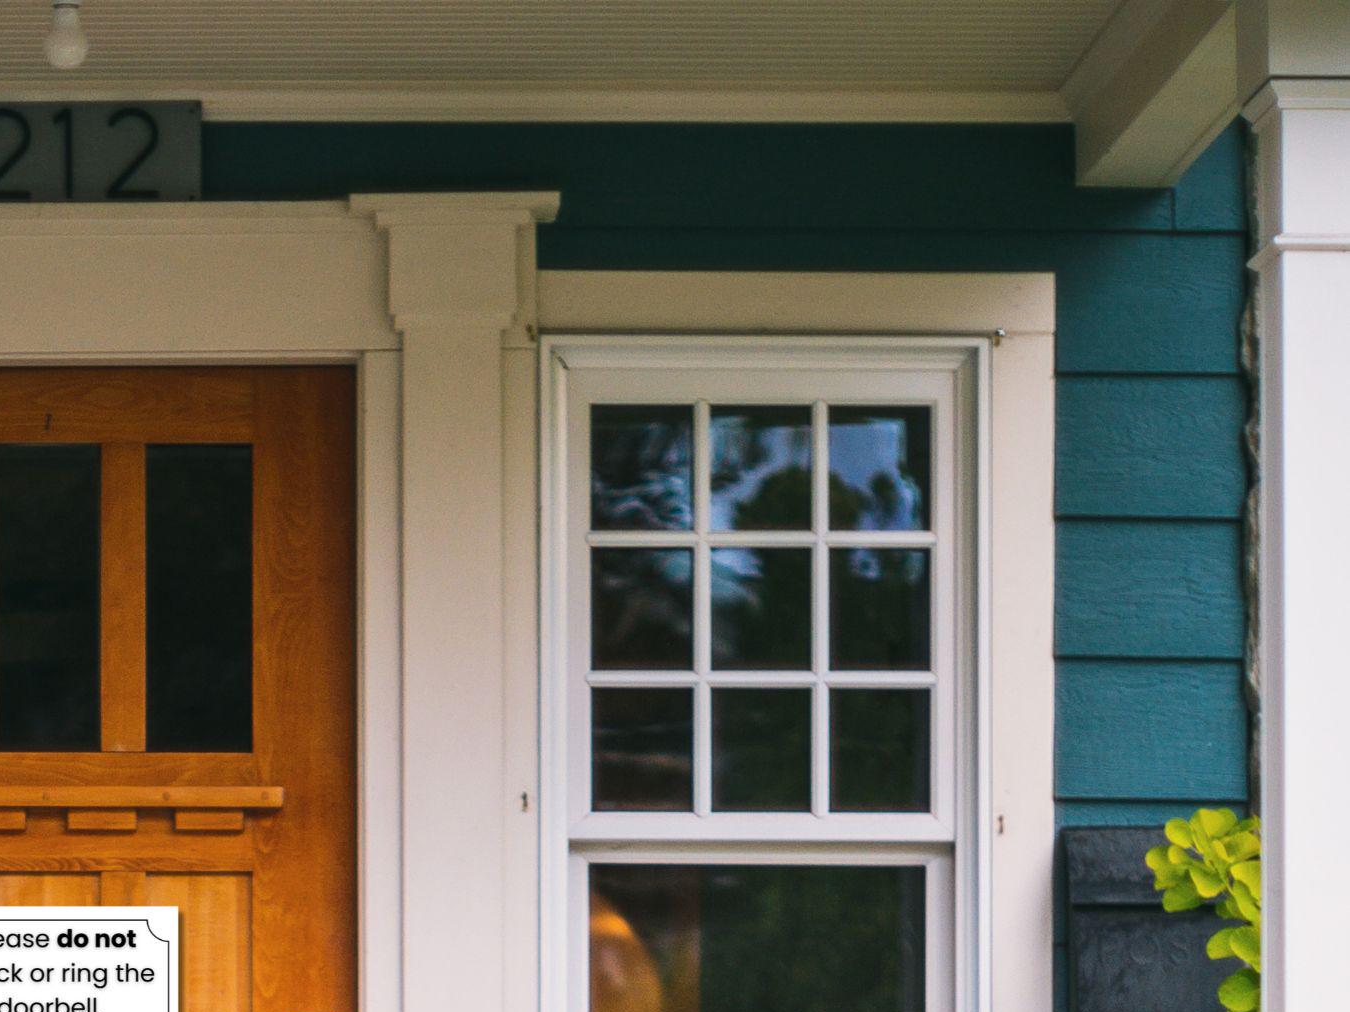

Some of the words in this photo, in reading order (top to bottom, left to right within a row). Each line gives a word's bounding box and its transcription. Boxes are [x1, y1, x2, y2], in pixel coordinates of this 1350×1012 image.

[56, 928, 89, 949] do
[95, 929, 137, 949] not
[29, 967, 55, 983] or
[62, 962, 108, 989] ring
[115, 963, 155, 983] the
